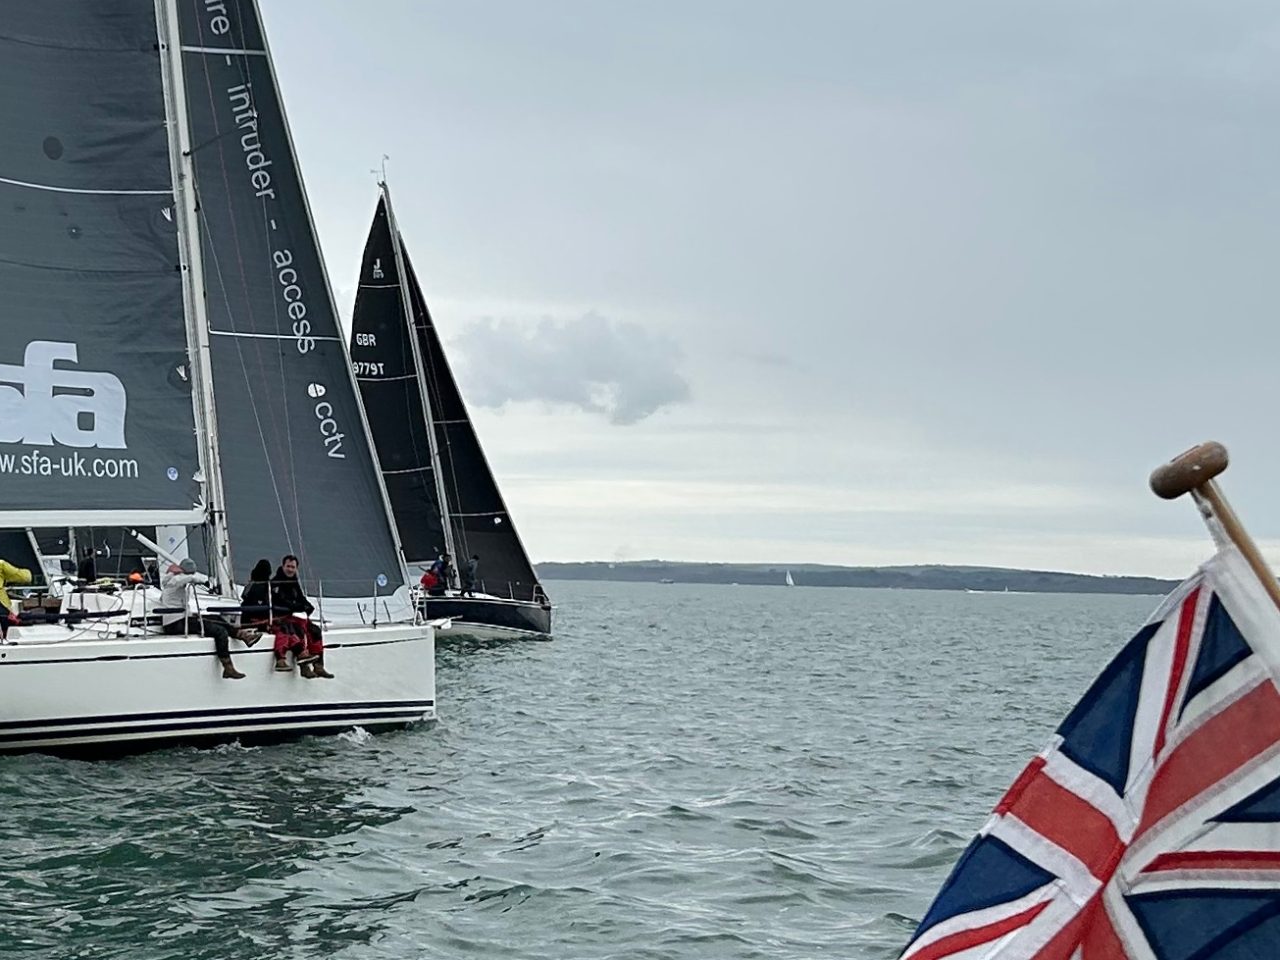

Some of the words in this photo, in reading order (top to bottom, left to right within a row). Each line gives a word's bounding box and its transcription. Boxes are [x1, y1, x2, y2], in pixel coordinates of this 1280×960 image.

[227, 82, 276, 200] intruder
[273, 249, 315, 354] access
[315, 401, 346, 459] cctv
[356, 333, 377, 347] GBR
